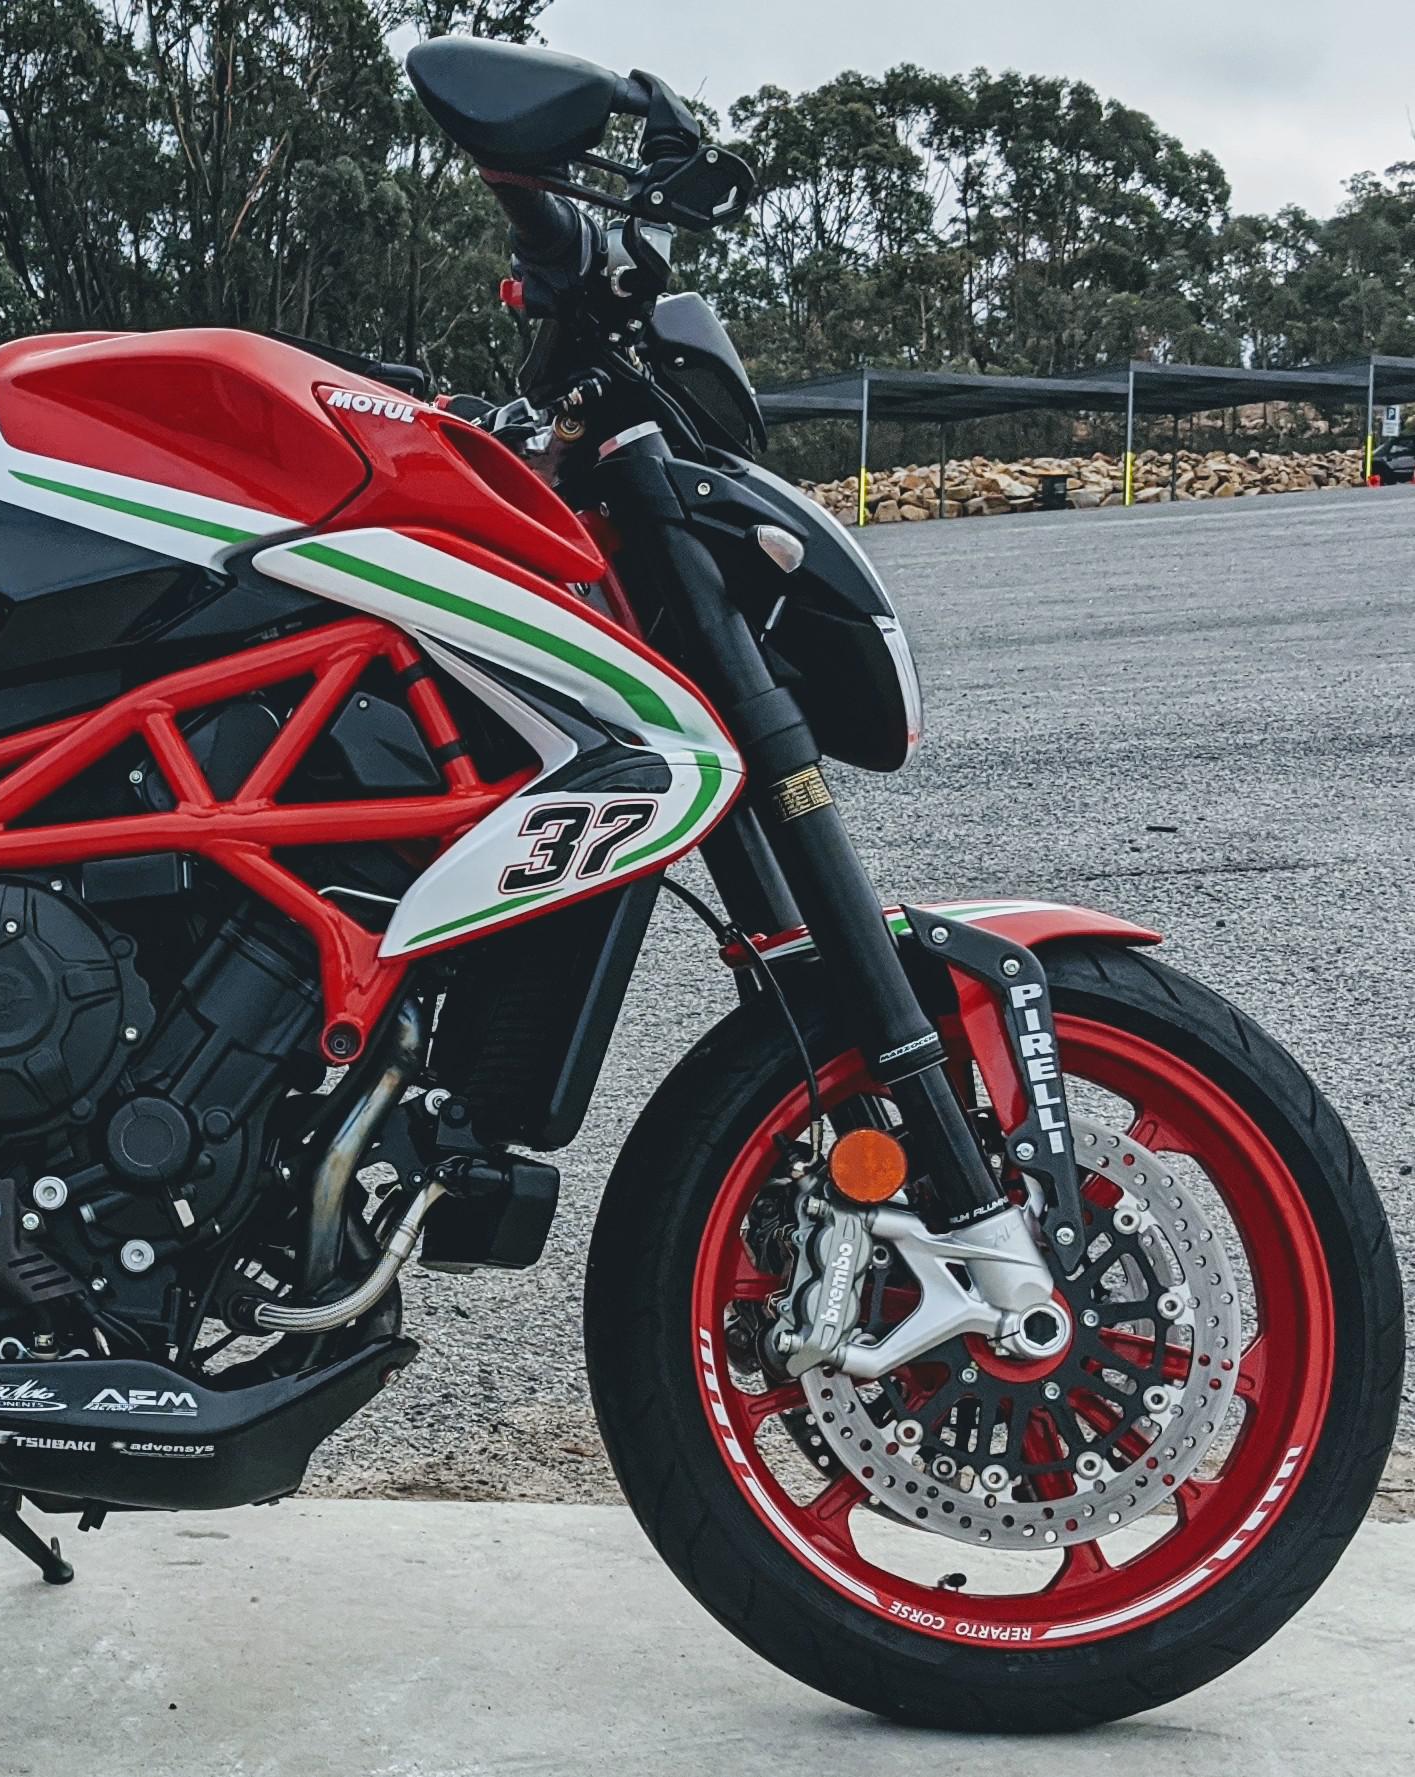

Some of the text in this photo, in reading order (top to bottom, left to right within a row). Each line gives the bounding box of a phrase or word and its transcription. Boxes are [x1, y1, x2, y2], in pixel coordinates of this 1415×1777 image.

[327, 391, 414, 423] MOTUL
[498, 799, 658, 894] 37
[1010, 983, 1065, 1154] PIRELLI
[821, 1243, 853, 1322] brembo
[12, 1435, 96, 1452] TSUBAKI
[130, 1443, 215, 1455] advensys
[888, 1601, 1032, 1640] REPARTO CORSE
